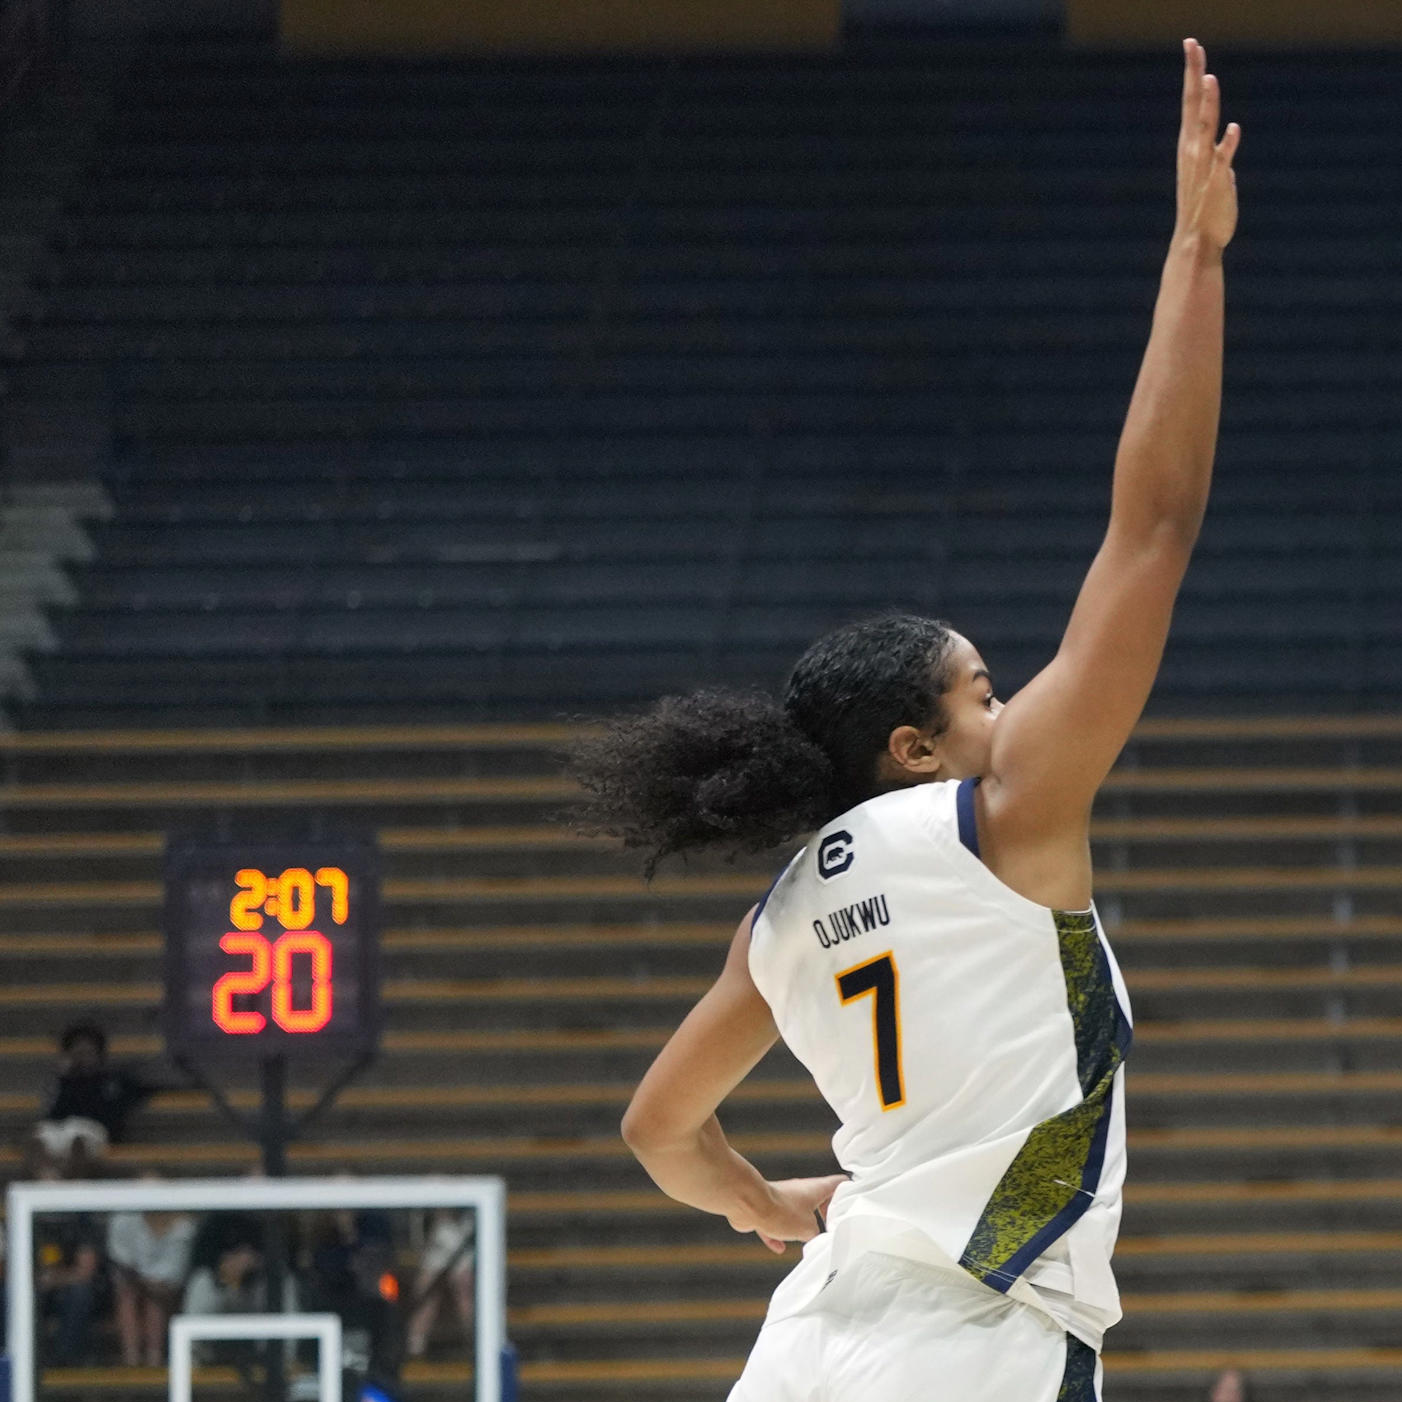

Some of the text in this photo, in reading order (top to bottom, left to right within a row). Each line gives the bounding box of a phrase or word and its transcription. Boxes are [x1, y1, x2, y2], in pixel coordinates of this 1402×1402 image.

[230, 867, 349, 931] 2:07
[812, 894, 891, 949] OJUKWU
[212, 930, 333, 1034] 20
[834, 950, 906, 1111] 7
